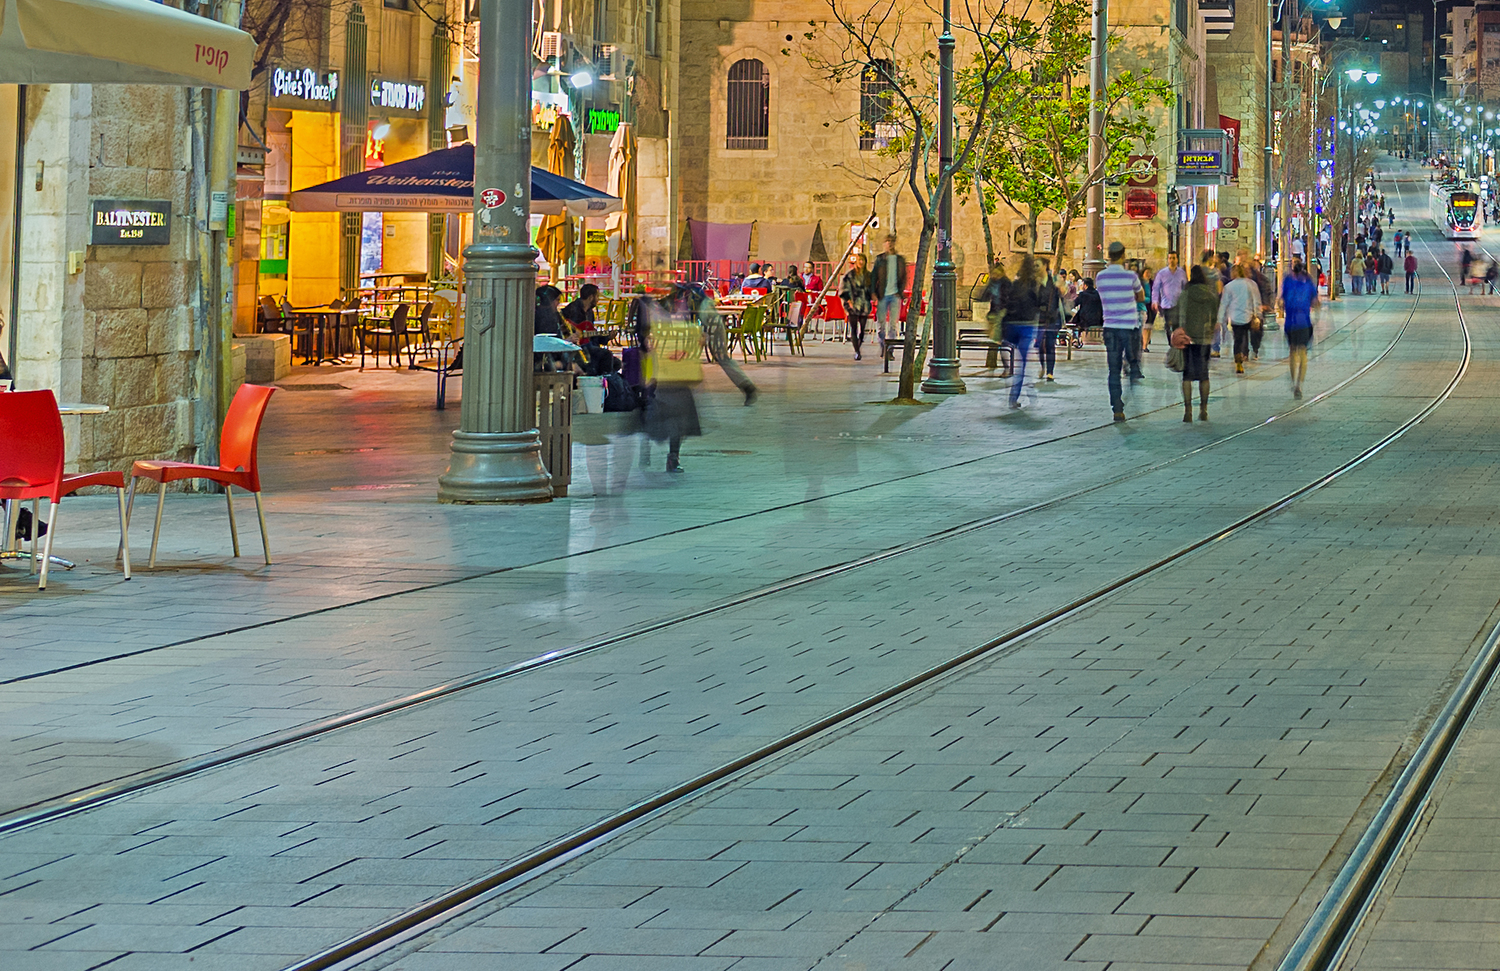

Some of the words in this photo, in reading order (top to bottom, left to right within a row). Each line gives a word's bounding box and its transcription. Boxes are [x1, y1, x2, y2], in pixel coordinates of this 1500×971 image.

[274, 66, 303, 97] Mike's
[302, 67, 328, 101] Place
[96, 210, 165, 227] BALTINESTER
